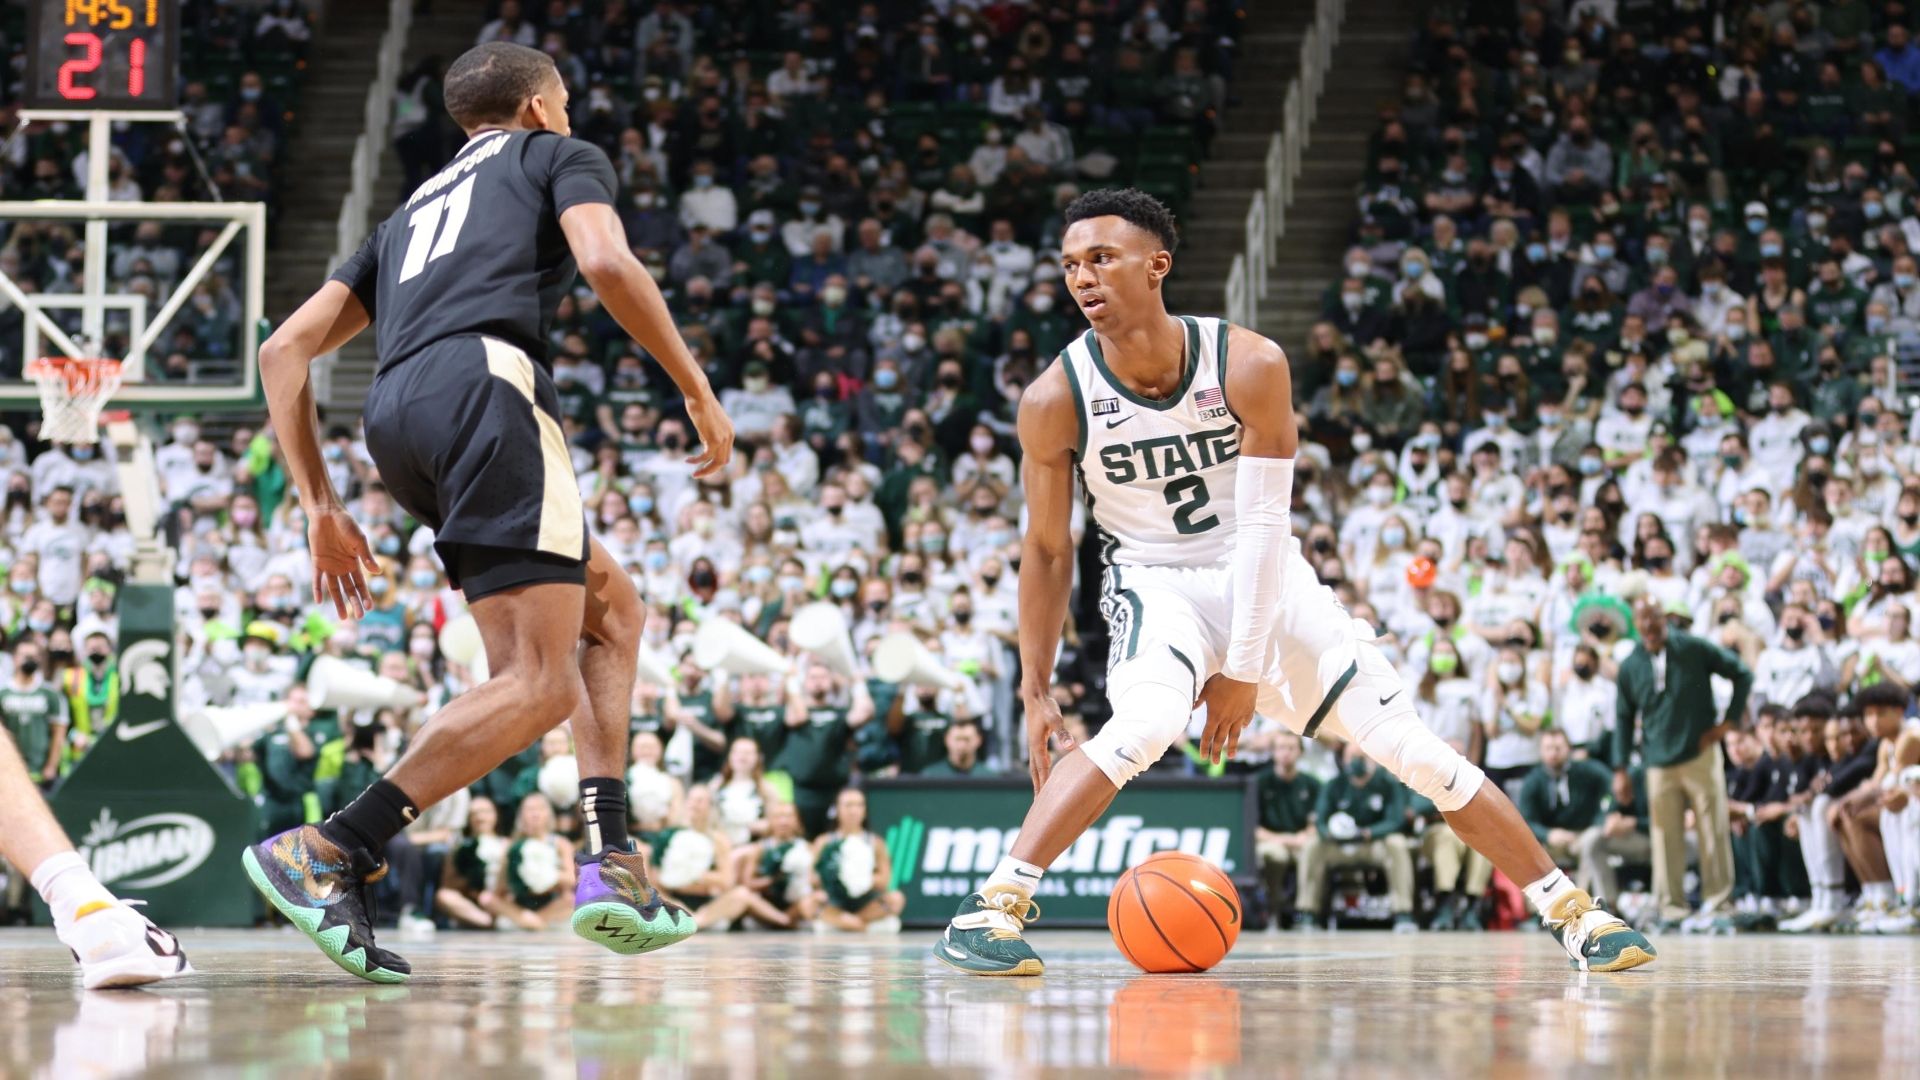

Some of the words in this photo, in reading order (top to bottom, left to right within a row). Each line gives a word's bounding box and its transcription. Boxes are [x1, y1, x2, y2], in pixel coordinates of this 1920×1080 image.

[58, 32, 145, 100] 21
[399, 172, 477, 284] 11
[1091, 398, 1119, 415] UNITY
[1099, 423, 1240, 485] STATE
[1163, 473, 1221, 535] 2
